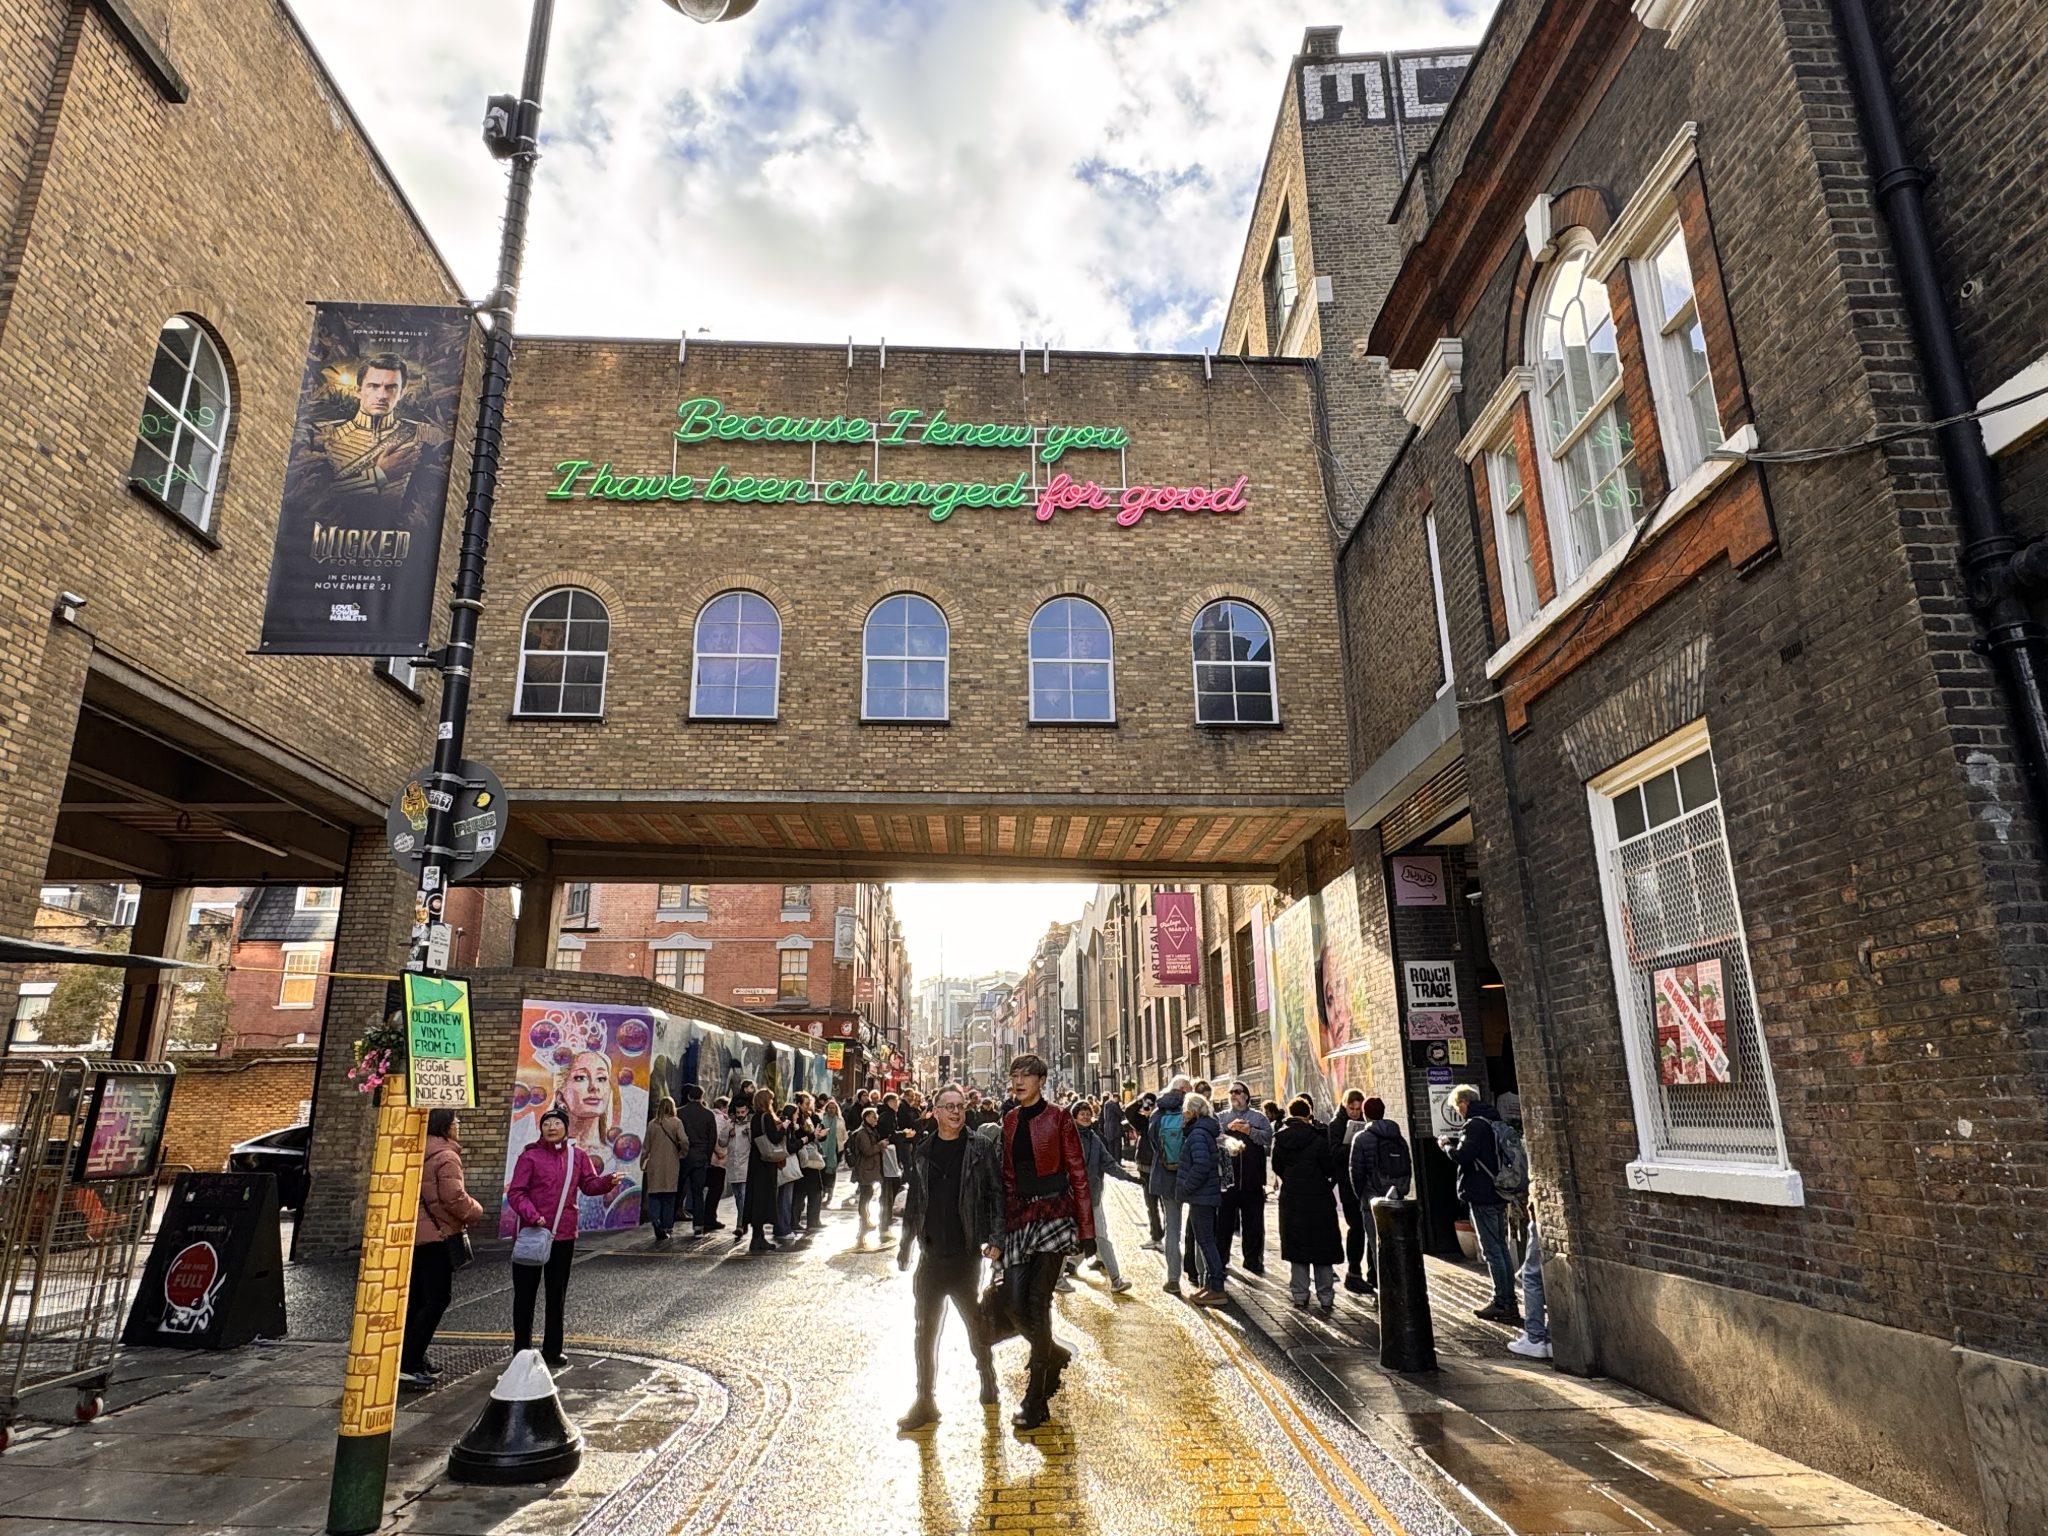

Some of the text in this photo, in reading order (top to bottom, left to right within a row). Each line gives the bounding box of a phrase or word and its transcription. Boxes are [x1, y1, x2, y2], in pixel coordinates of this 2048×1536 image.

[674, 397, 1131, 463] Because I knew you
[546, 459, 1250, 527] I have been changed for good
[309, 521, 411, 564] WICKED
[329, 559, 403, 568] FOR GOOD
[341, 574, 382, 582] CINEMAS
[314, 582, 391, 591] NOVEMBER 21
[1149, 926, 1161, 980] ARTISAN
[1410, 967, 1451, 983] ROUGH
[1412, 983, 1453, 999] TRADE
[1663, 976, 1674, 994] DR
[1686, 1013, 1717, 1061] MARTENS
[420, 1026, 449, 1041] VINYL
[414, 1040, 457, 1054] FROM £1
[415, 1074, 441, 1086] DISCO
[415, 1088, 466, 1101] INDIE 45 12
[172, 1274, 203, 1288] FULL
